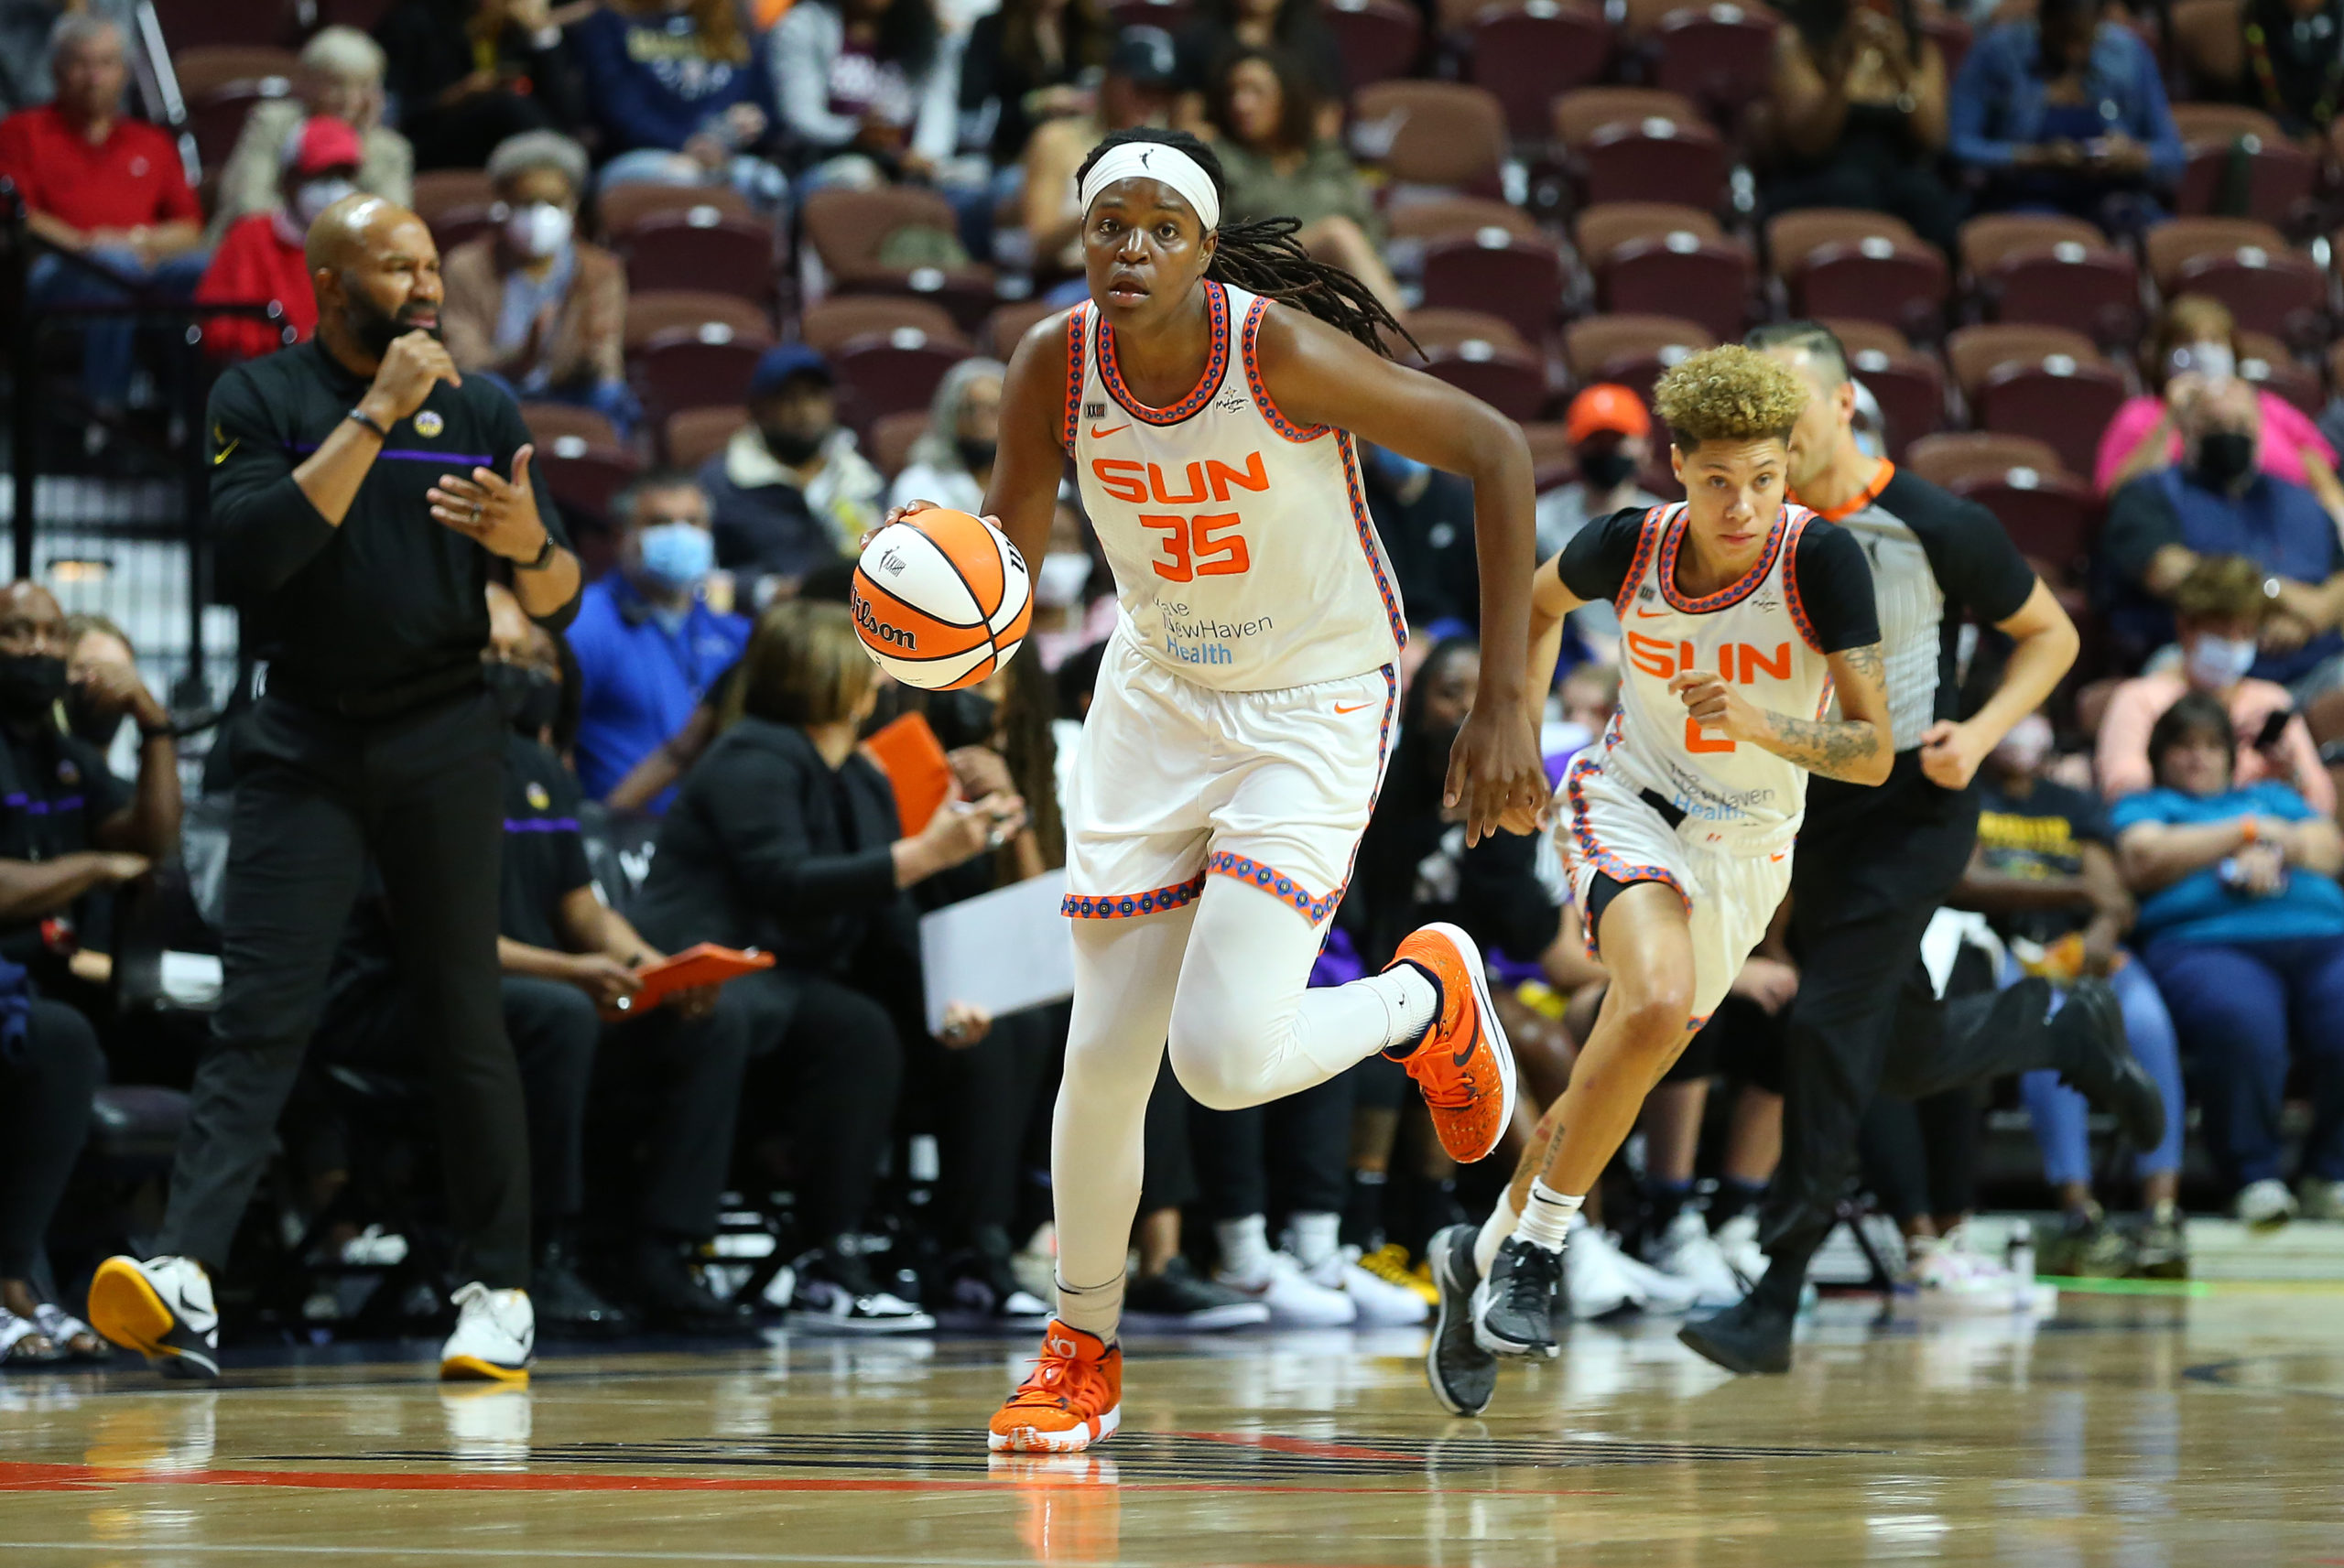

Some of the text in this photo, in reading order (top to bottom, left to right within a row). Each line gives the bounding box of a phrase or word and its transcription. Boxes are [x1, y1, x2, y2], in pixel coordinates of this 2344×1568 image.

[1091, 450, 1270, 504] SUN
[1138, 512, 1251, 583] 35
[1167, 633, 1232, 665] Health
[1627, 631, 1792, 685] SUN
